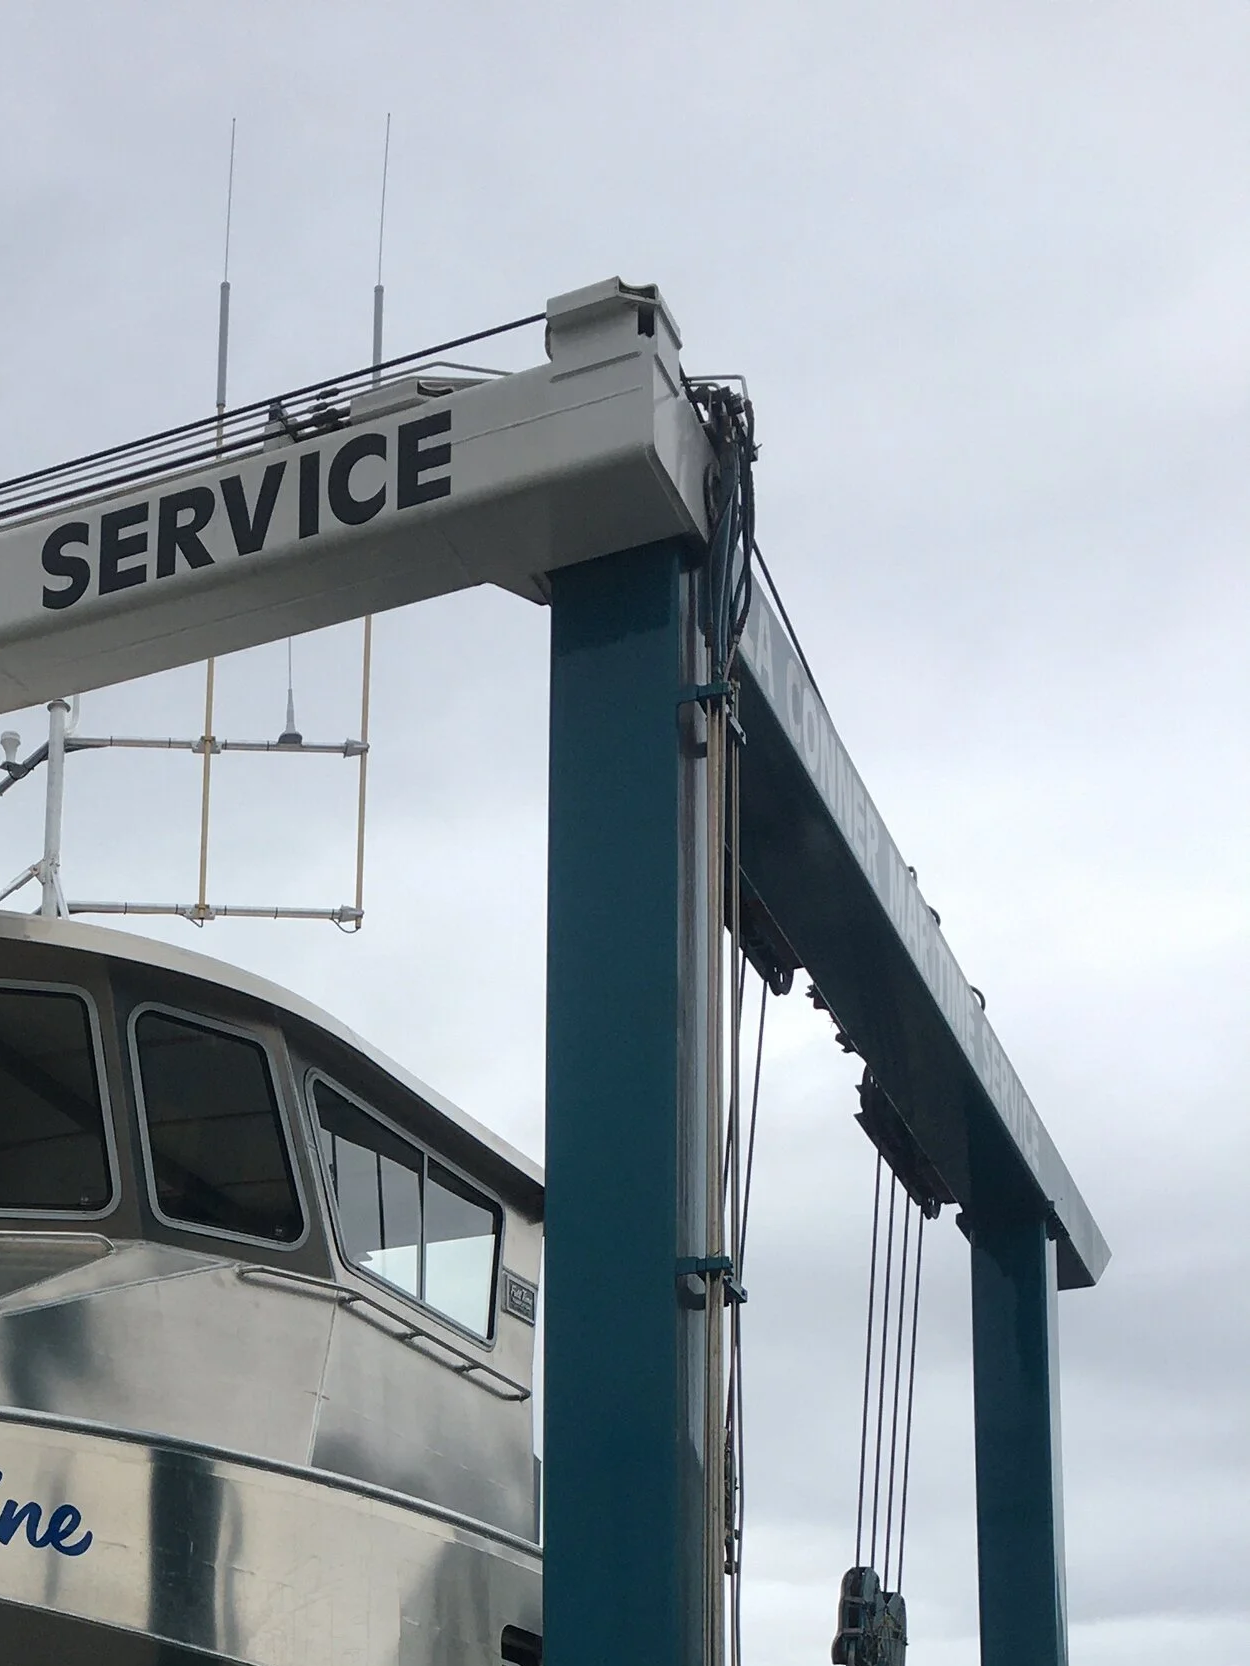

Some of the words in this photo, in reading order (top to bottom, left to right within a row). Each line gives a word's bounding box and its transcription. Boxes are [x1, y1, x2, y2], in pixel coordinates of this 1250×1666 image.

[41, 410, 452, 610] SERVICE
[786, 658, 880, 889] CONNER
[981, 1019, 1041, 1173] SERVICE
